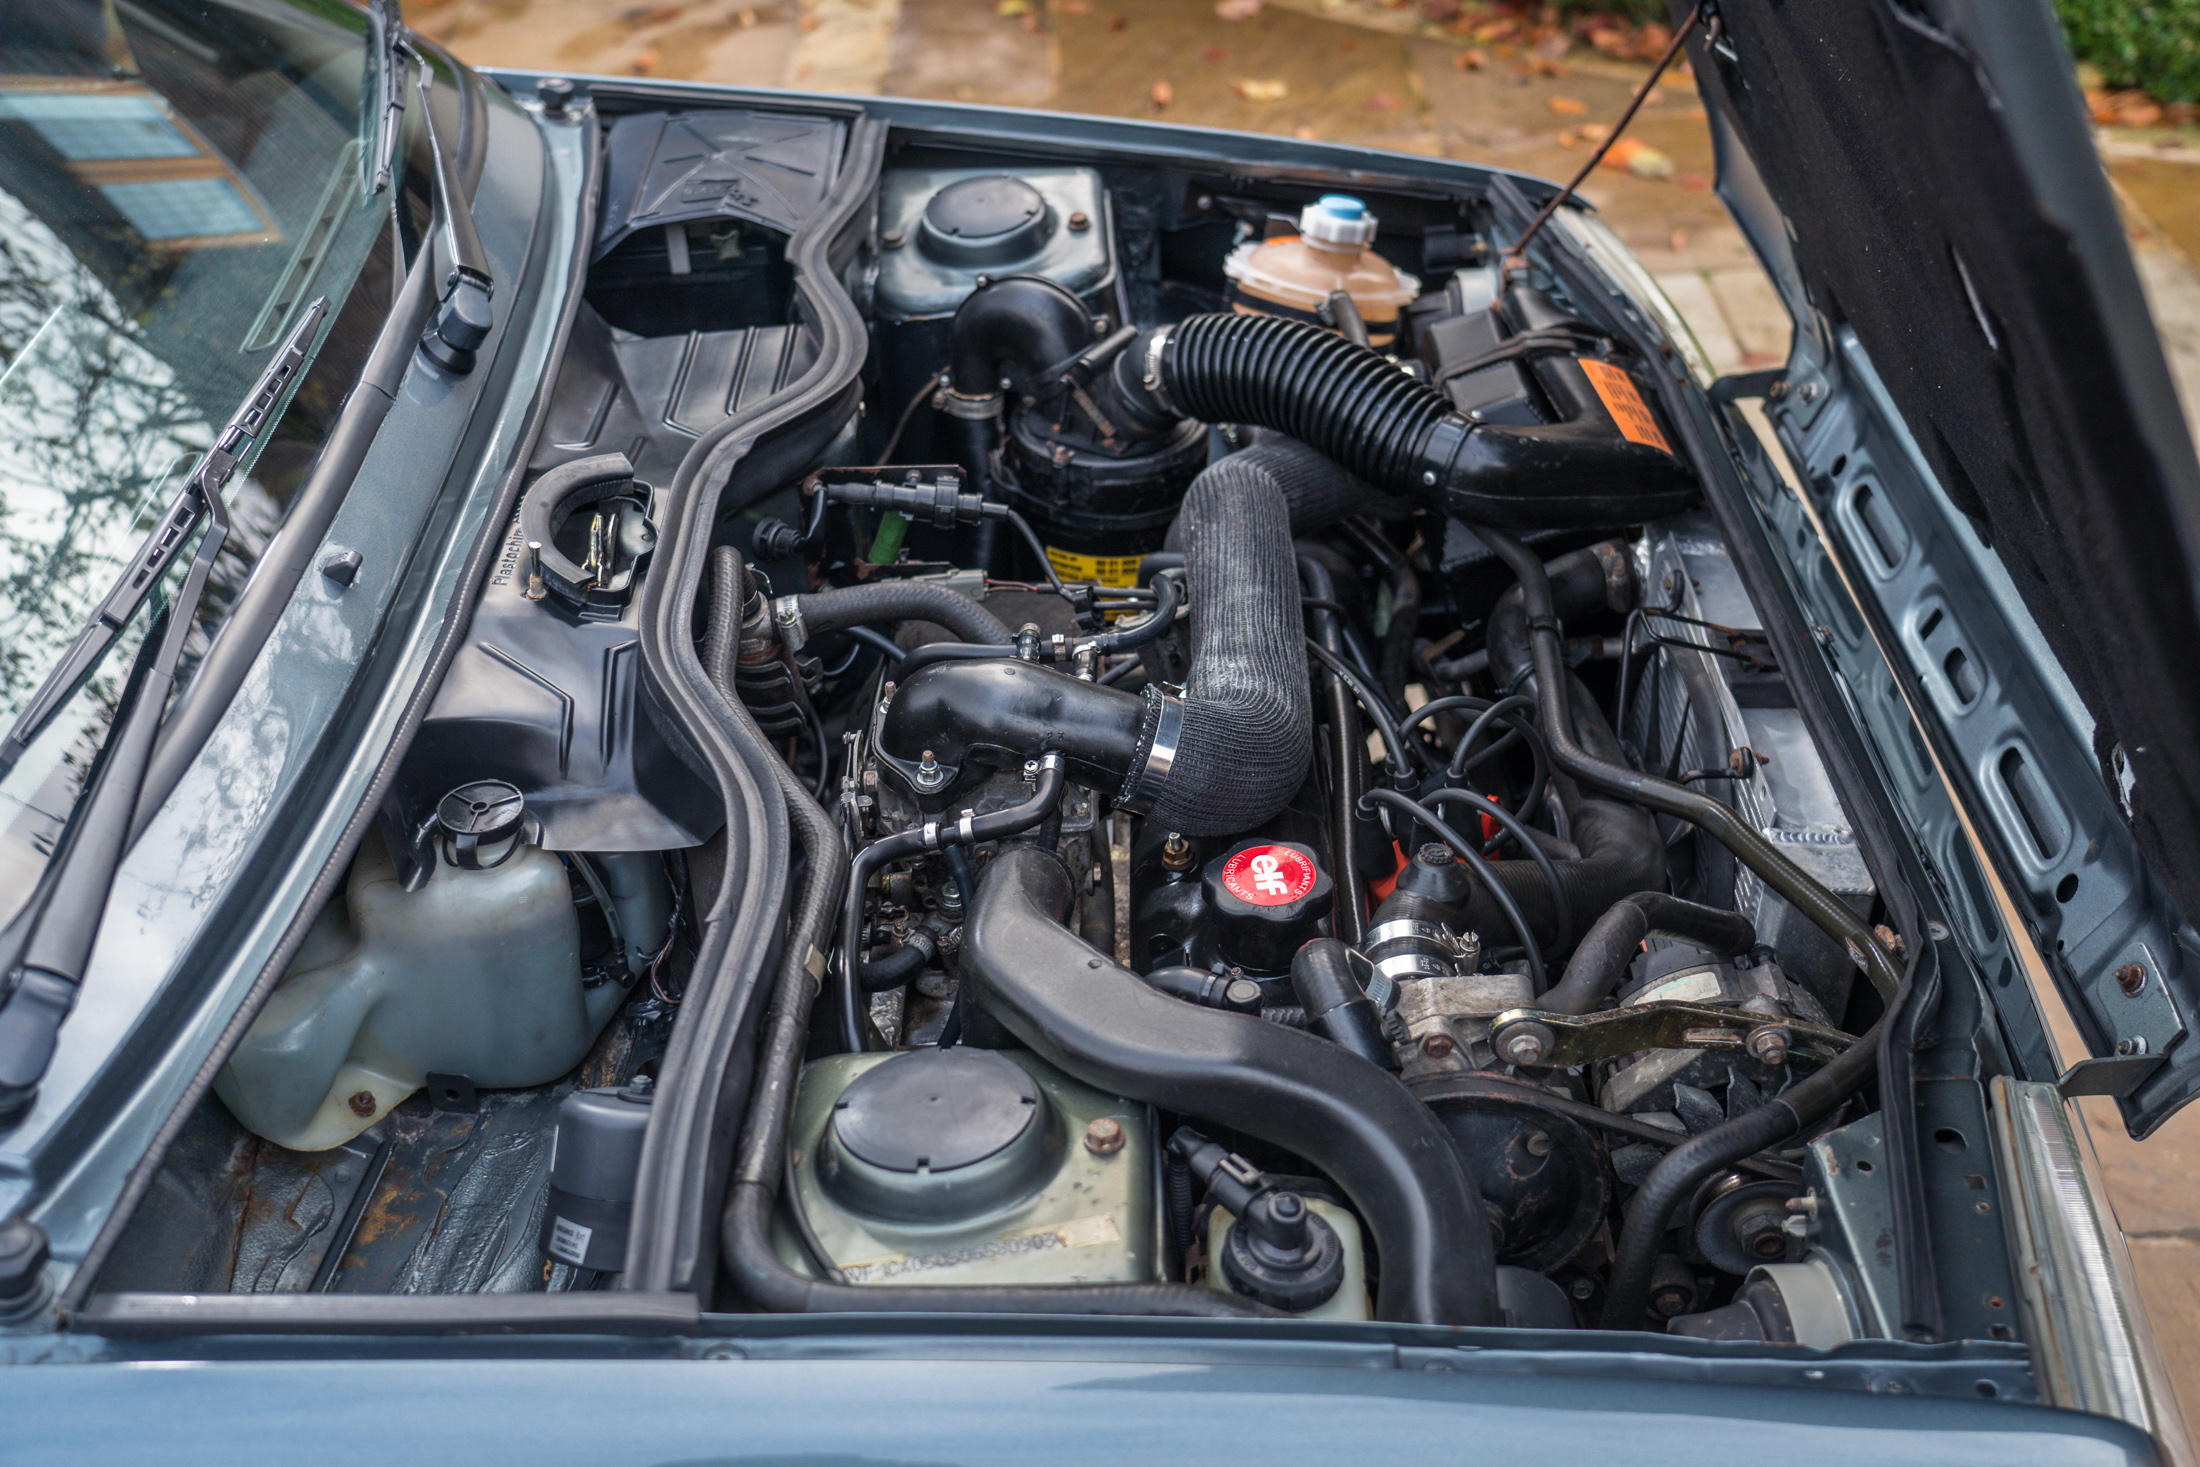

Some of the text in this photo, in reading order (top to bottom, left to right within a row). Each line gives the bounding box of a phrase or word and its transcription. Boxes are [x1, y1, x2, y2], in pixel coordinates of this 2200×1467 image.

[1226, 854, 1255, 900] LUBRICANTS
[1250, 854, 1288, 896] elf
[1284, 850, 1311, 895] LUBRIFIANTS
